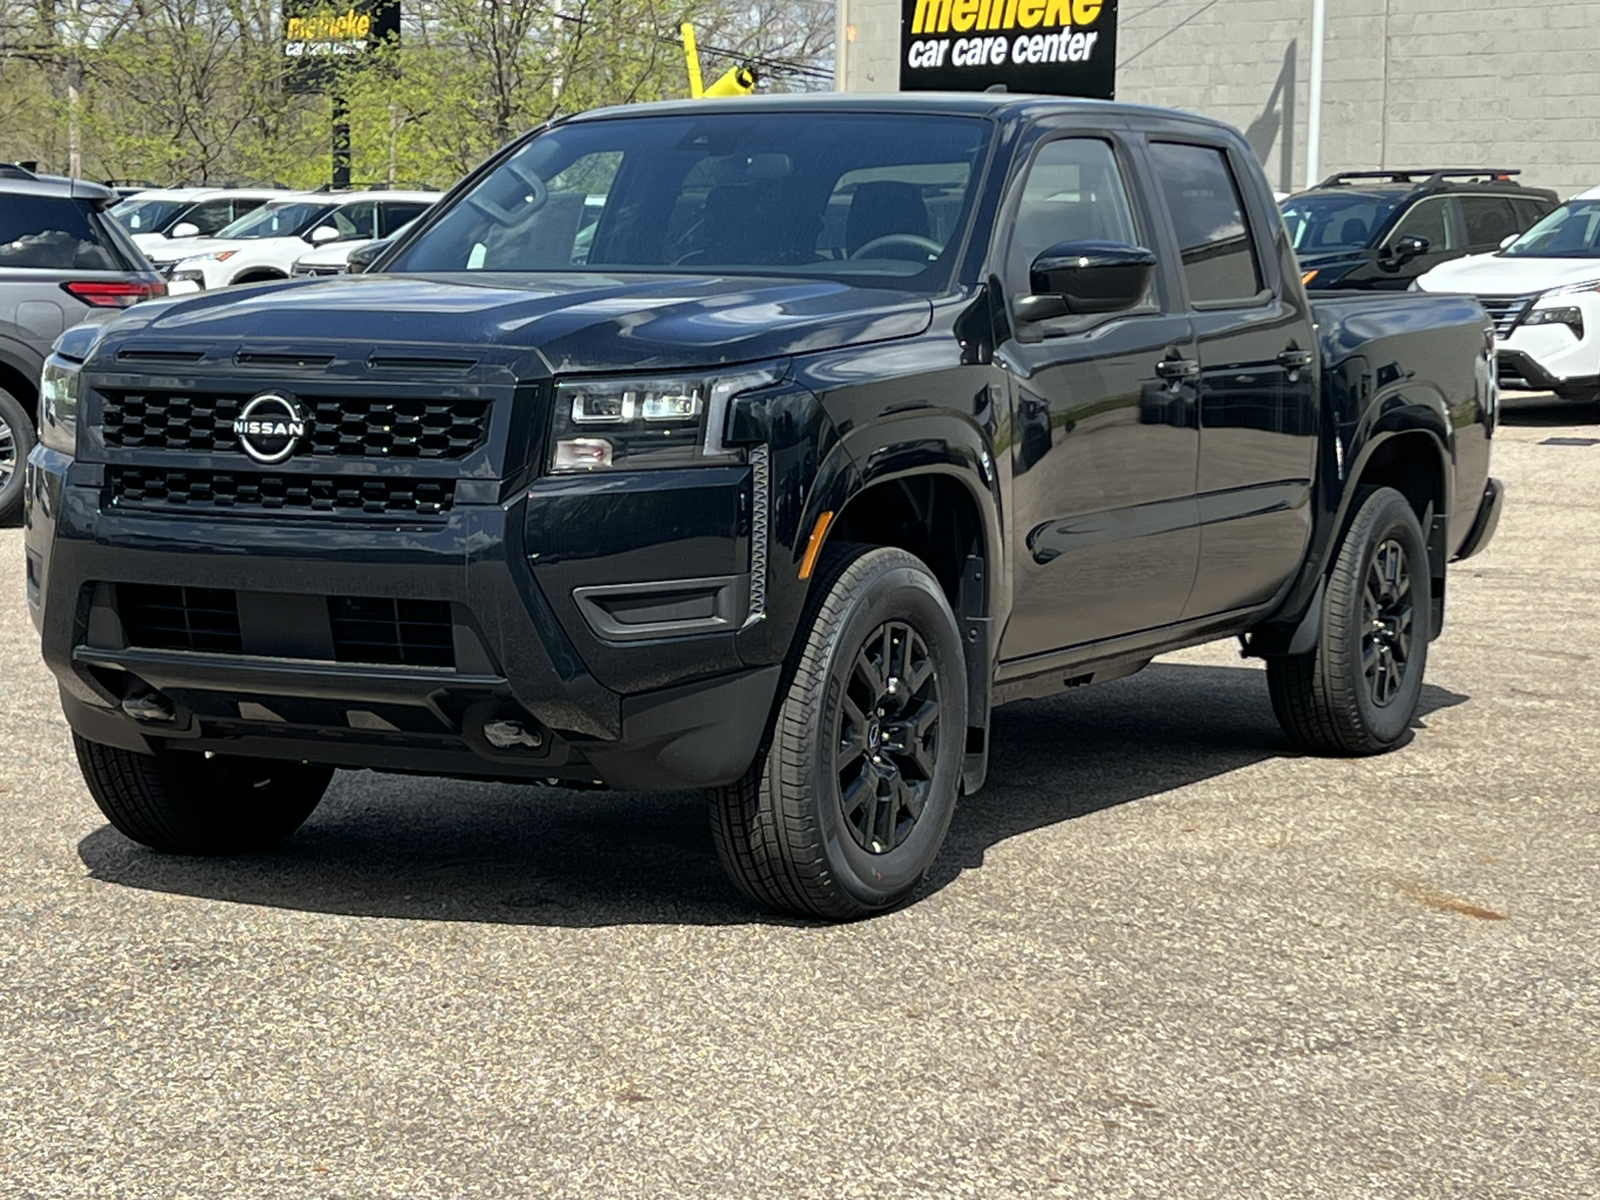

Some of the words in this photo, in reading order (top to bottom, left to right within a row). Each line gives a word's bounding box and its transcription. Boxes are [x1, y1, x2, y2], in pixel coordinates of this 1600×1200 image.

[907, 38, 949, 68] car
[952, 34, 1008, 66] care
[1011, 26, 1098, 64] center
[233, 421, 304, 435] NISSAN
